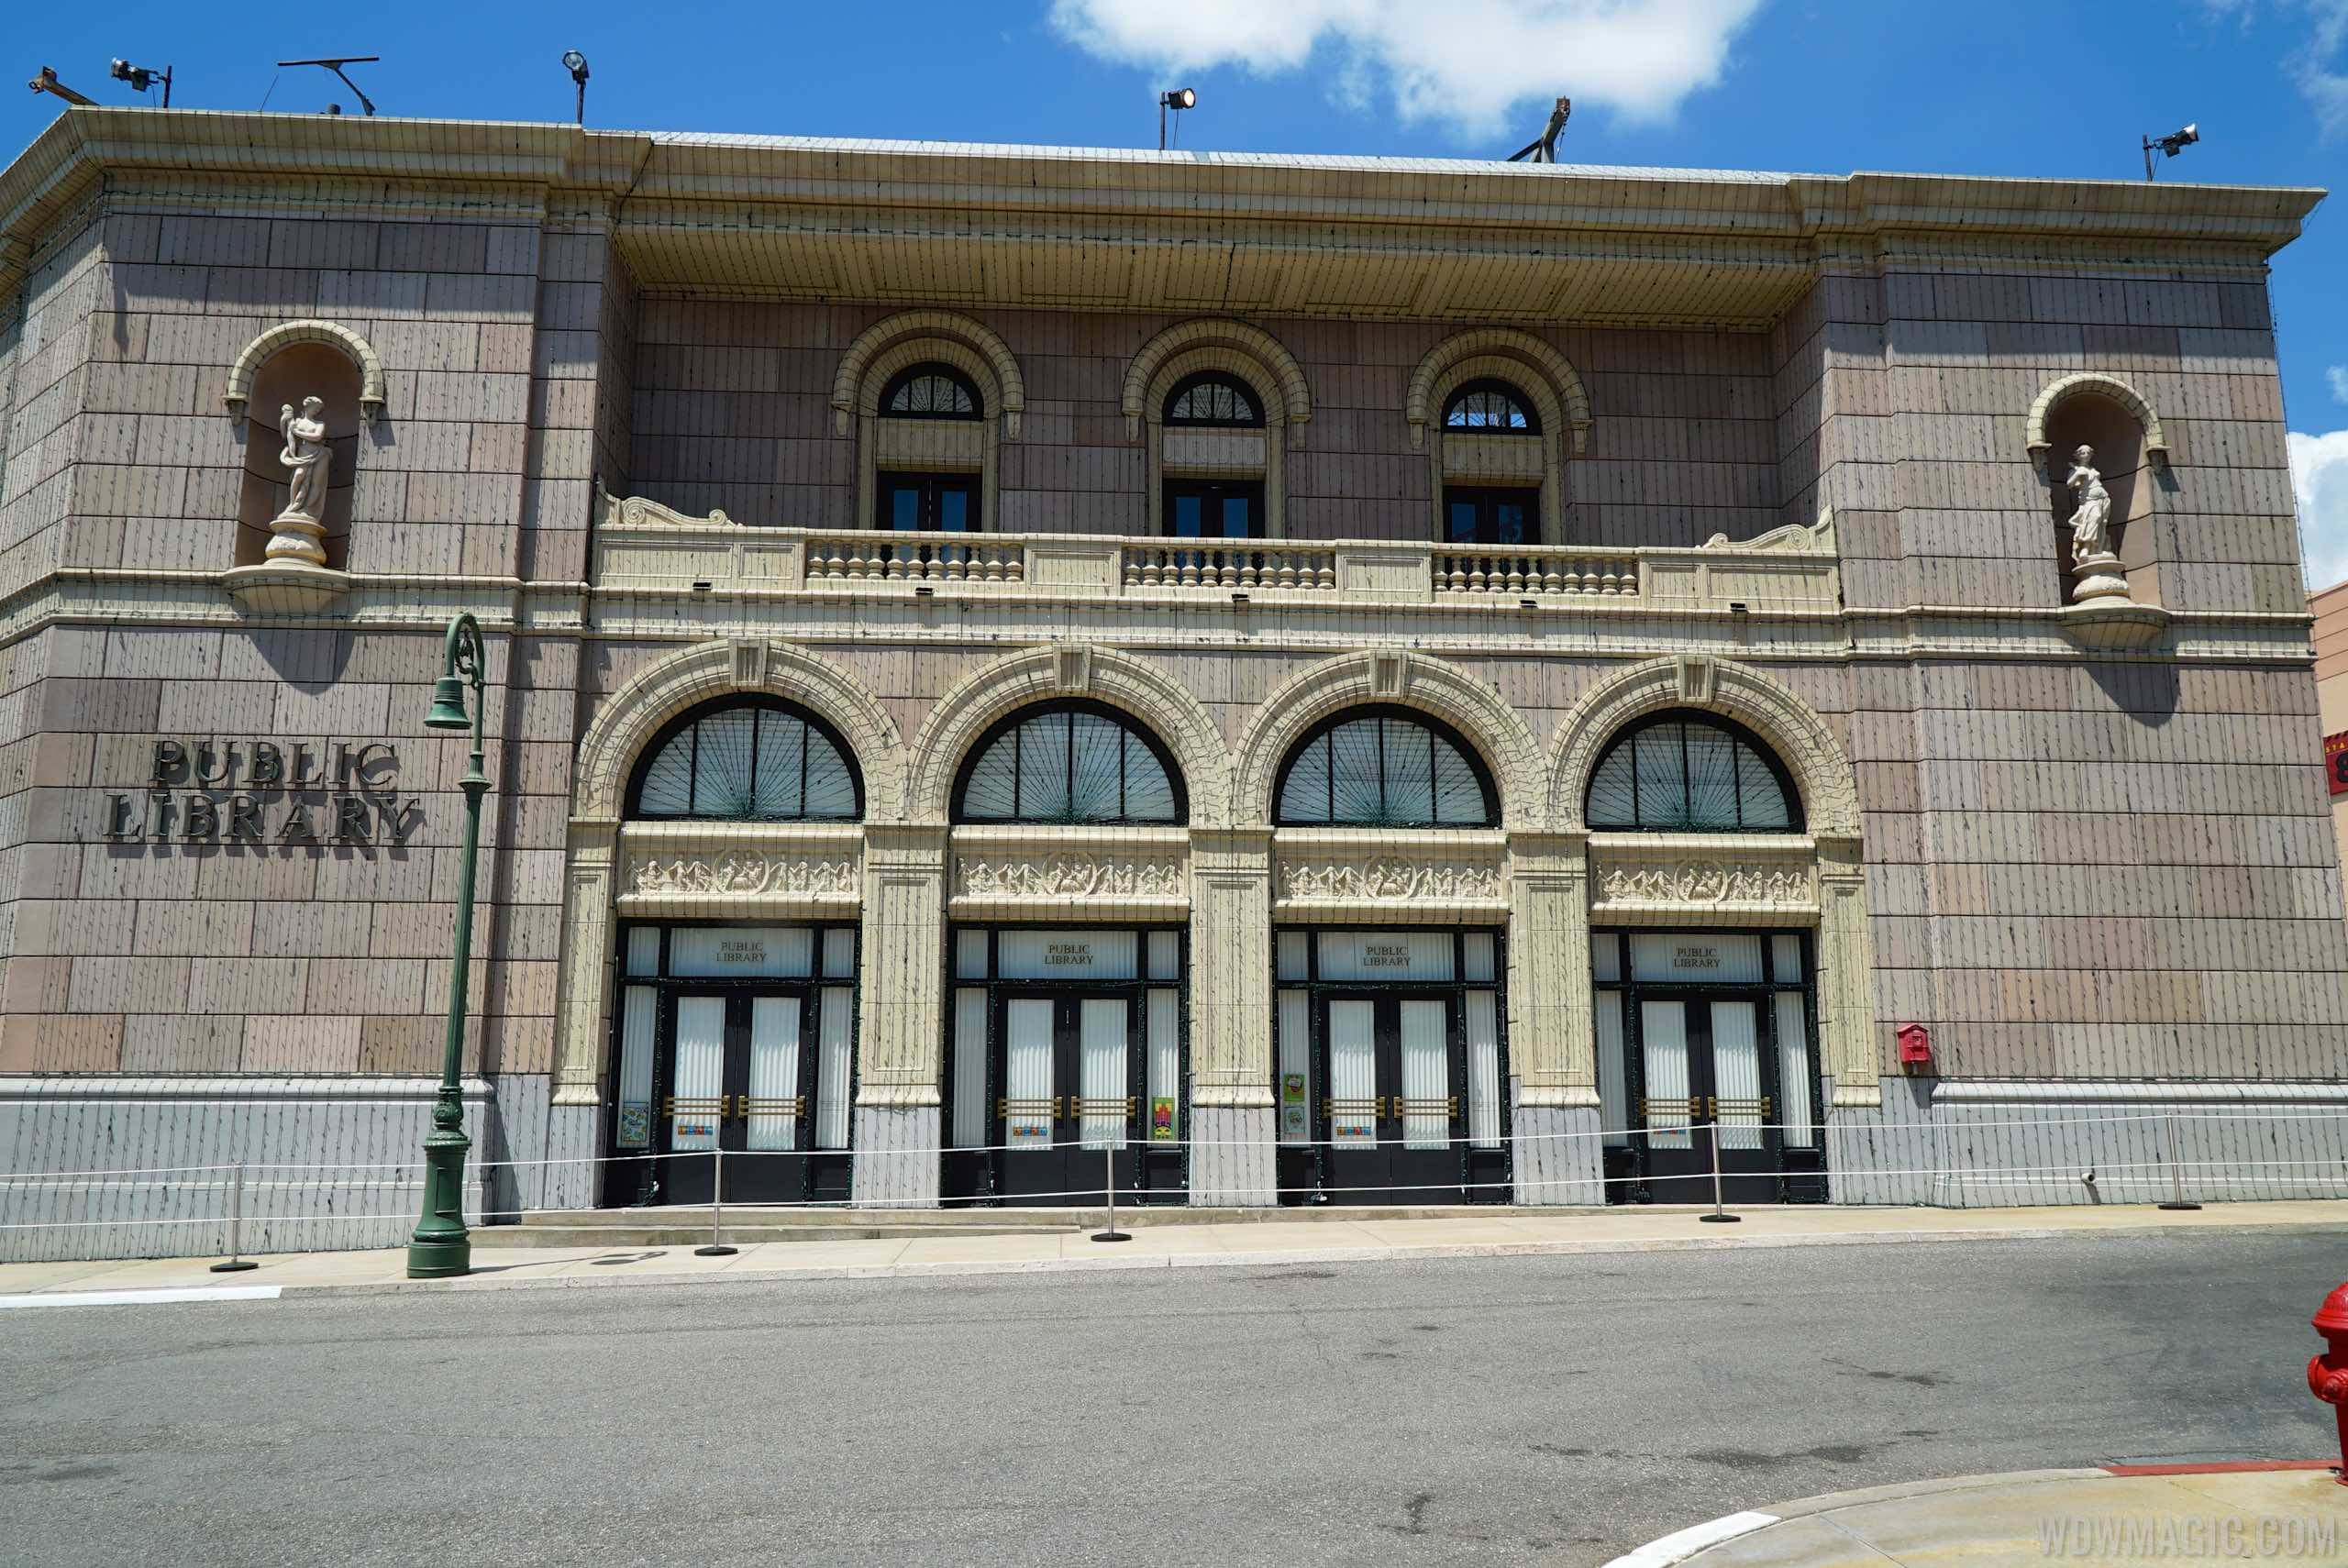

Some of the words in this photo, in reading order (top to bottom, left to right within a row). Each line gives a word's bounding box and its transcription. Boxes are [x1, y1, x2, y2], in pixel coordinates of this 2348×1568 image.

[148, 740, 395, 786] PUBLIC
[103, 793, 420, 841] LIBRARY
[720, 941, 764, 952] PUBLIC
[1048, 944, 1091, 955] PUBLIC
[1366, 946, 1408, 955] PUBLIC
[1677, 947, 1717, 957] PUBLIC
[715, 953, 768, 962] LIBRARY
[1045, 955, 1093, 965] LIBRARY
[1363, 956, 1411, 966] LIBRARY
[1673, 958, 1721, 968] LIBRARY
